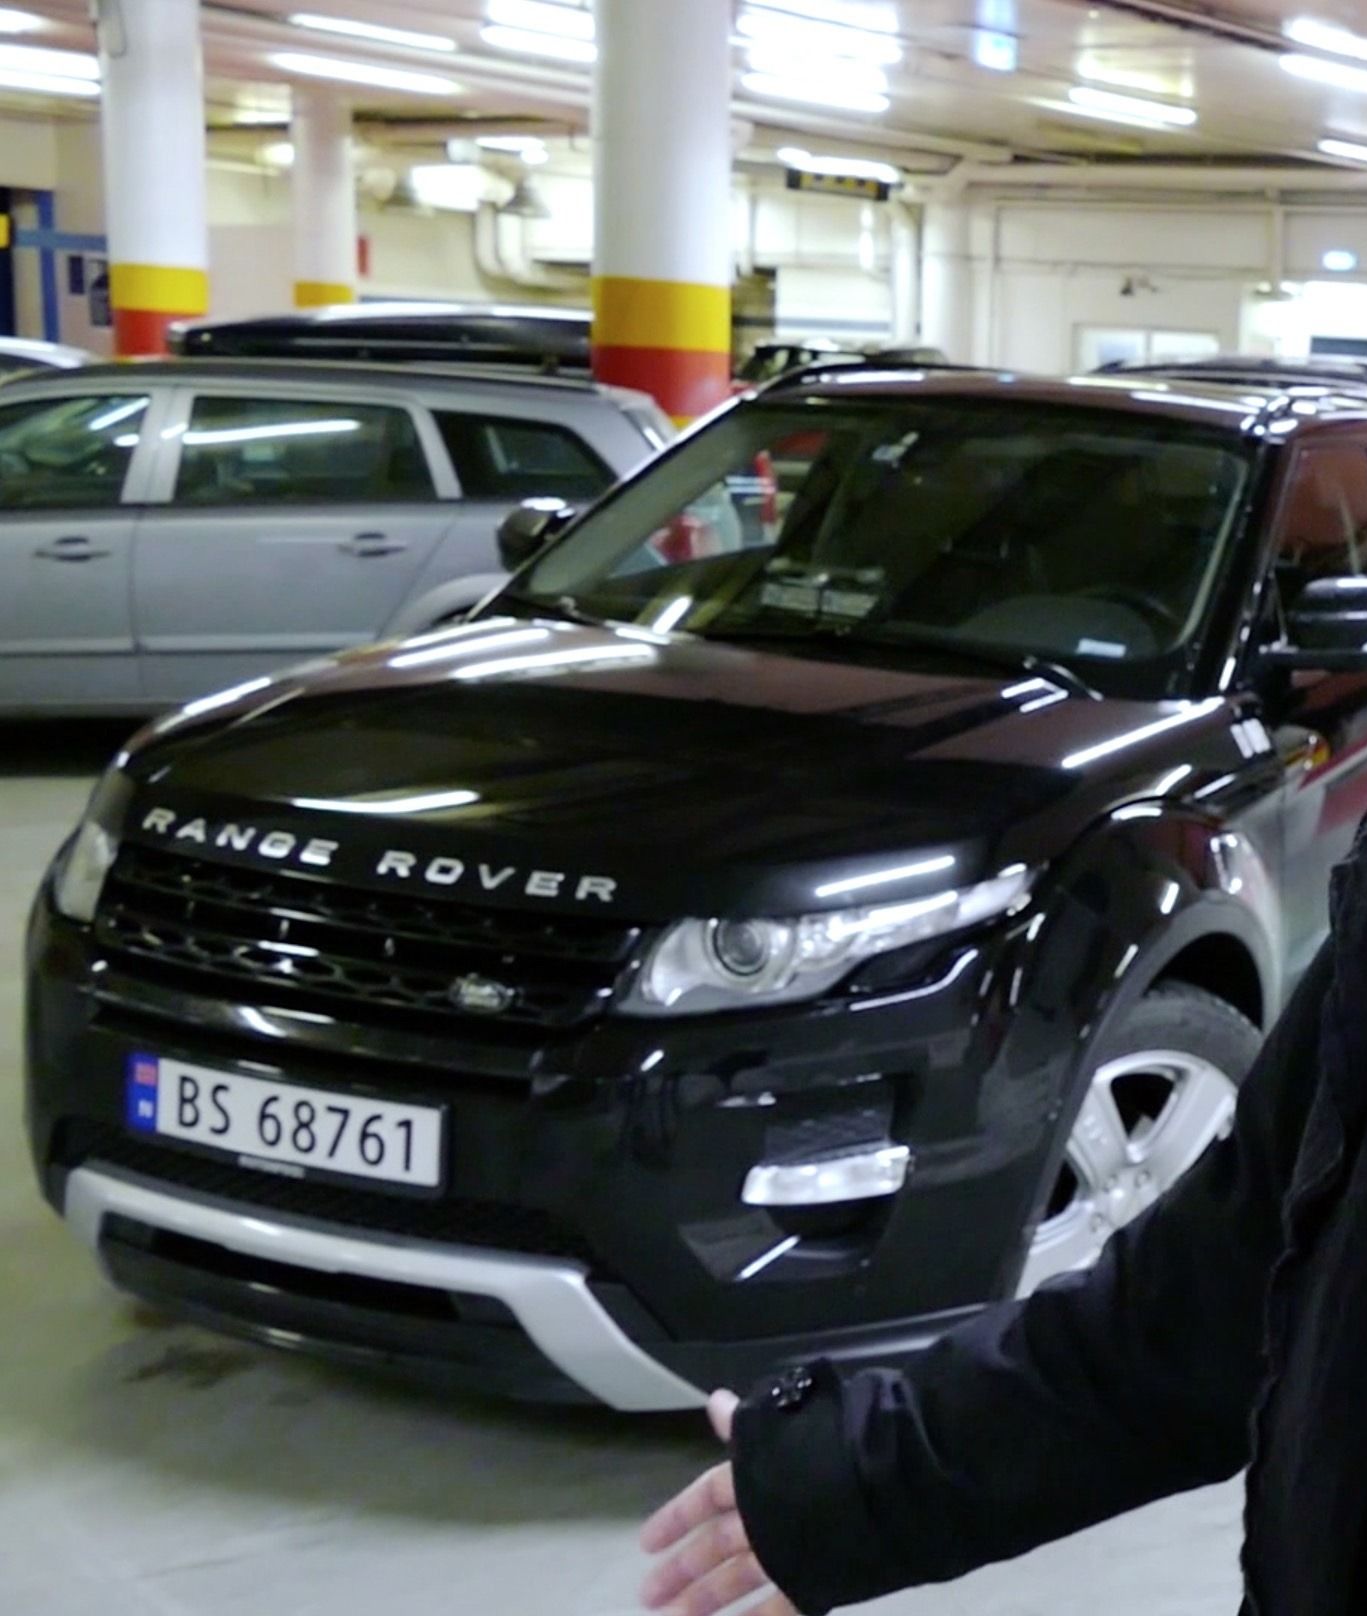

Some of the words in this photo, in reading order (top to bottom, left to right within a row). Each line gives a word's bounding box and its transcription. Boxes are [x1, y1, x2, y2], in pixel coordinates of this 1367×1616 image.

[142, 807, 339, 866] RANGE
[376, 850, 617, 902] ROVER
[178, 1074, 231, 1136] BS
[258, 1095, 413, 1172] 68761
